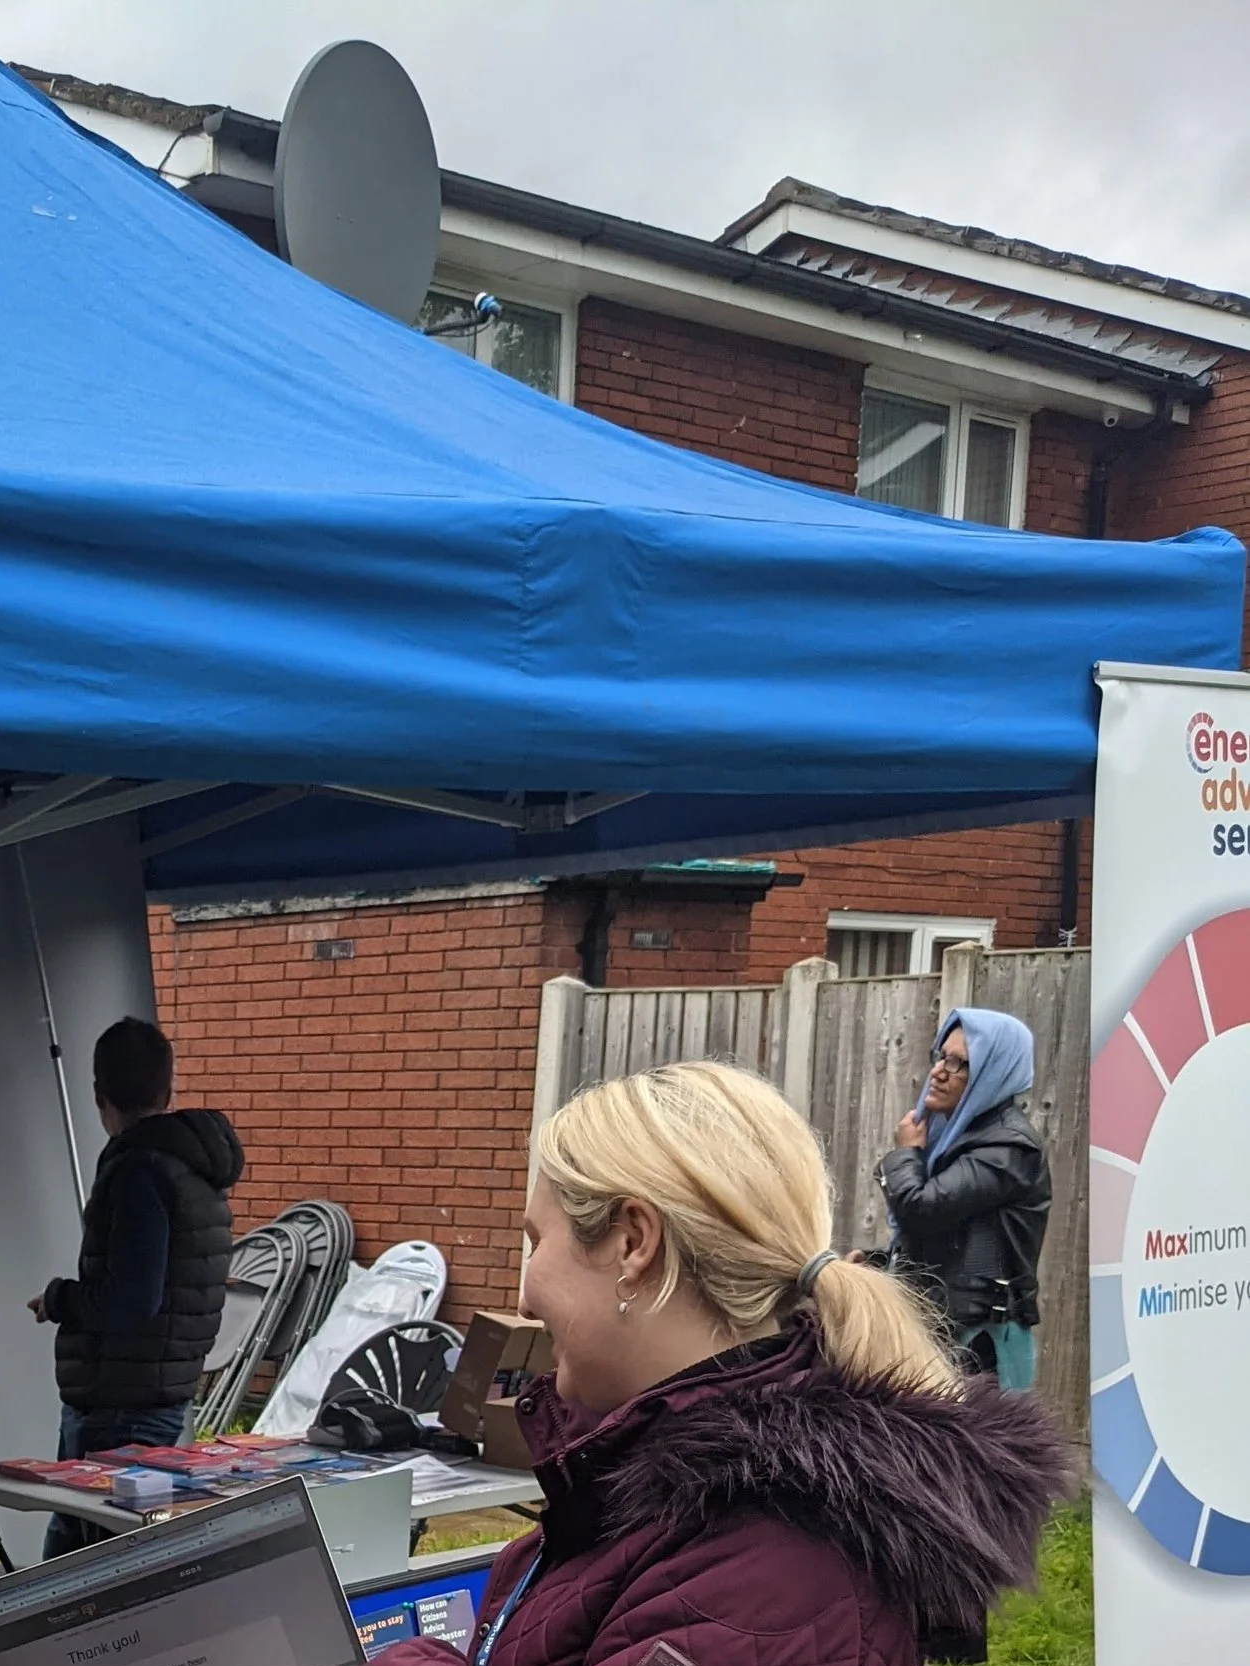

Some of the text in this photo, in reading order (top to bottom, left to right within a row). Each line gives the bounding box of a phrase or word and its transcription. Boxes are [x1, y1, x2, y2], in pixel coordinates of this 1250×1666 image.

[1194, 728, 1250, 764] ene
[1213, 823, 1250, 856] se
[1145, 1225, 1246, 1261] Maximum
[1138, 1279, 1227, 1318] Minimise
[419, 1600, 448, 1612] How can
[421, 1611, 448, 1624] Citizens
[362, 1623, 377, 1635] you
[378, 1620, 387, 1629] to
[387, 1614, 404, 1626] stay
[423, 1622, 446, 1635] Advice
[67, 1630, 141, 1665] Thank you!
